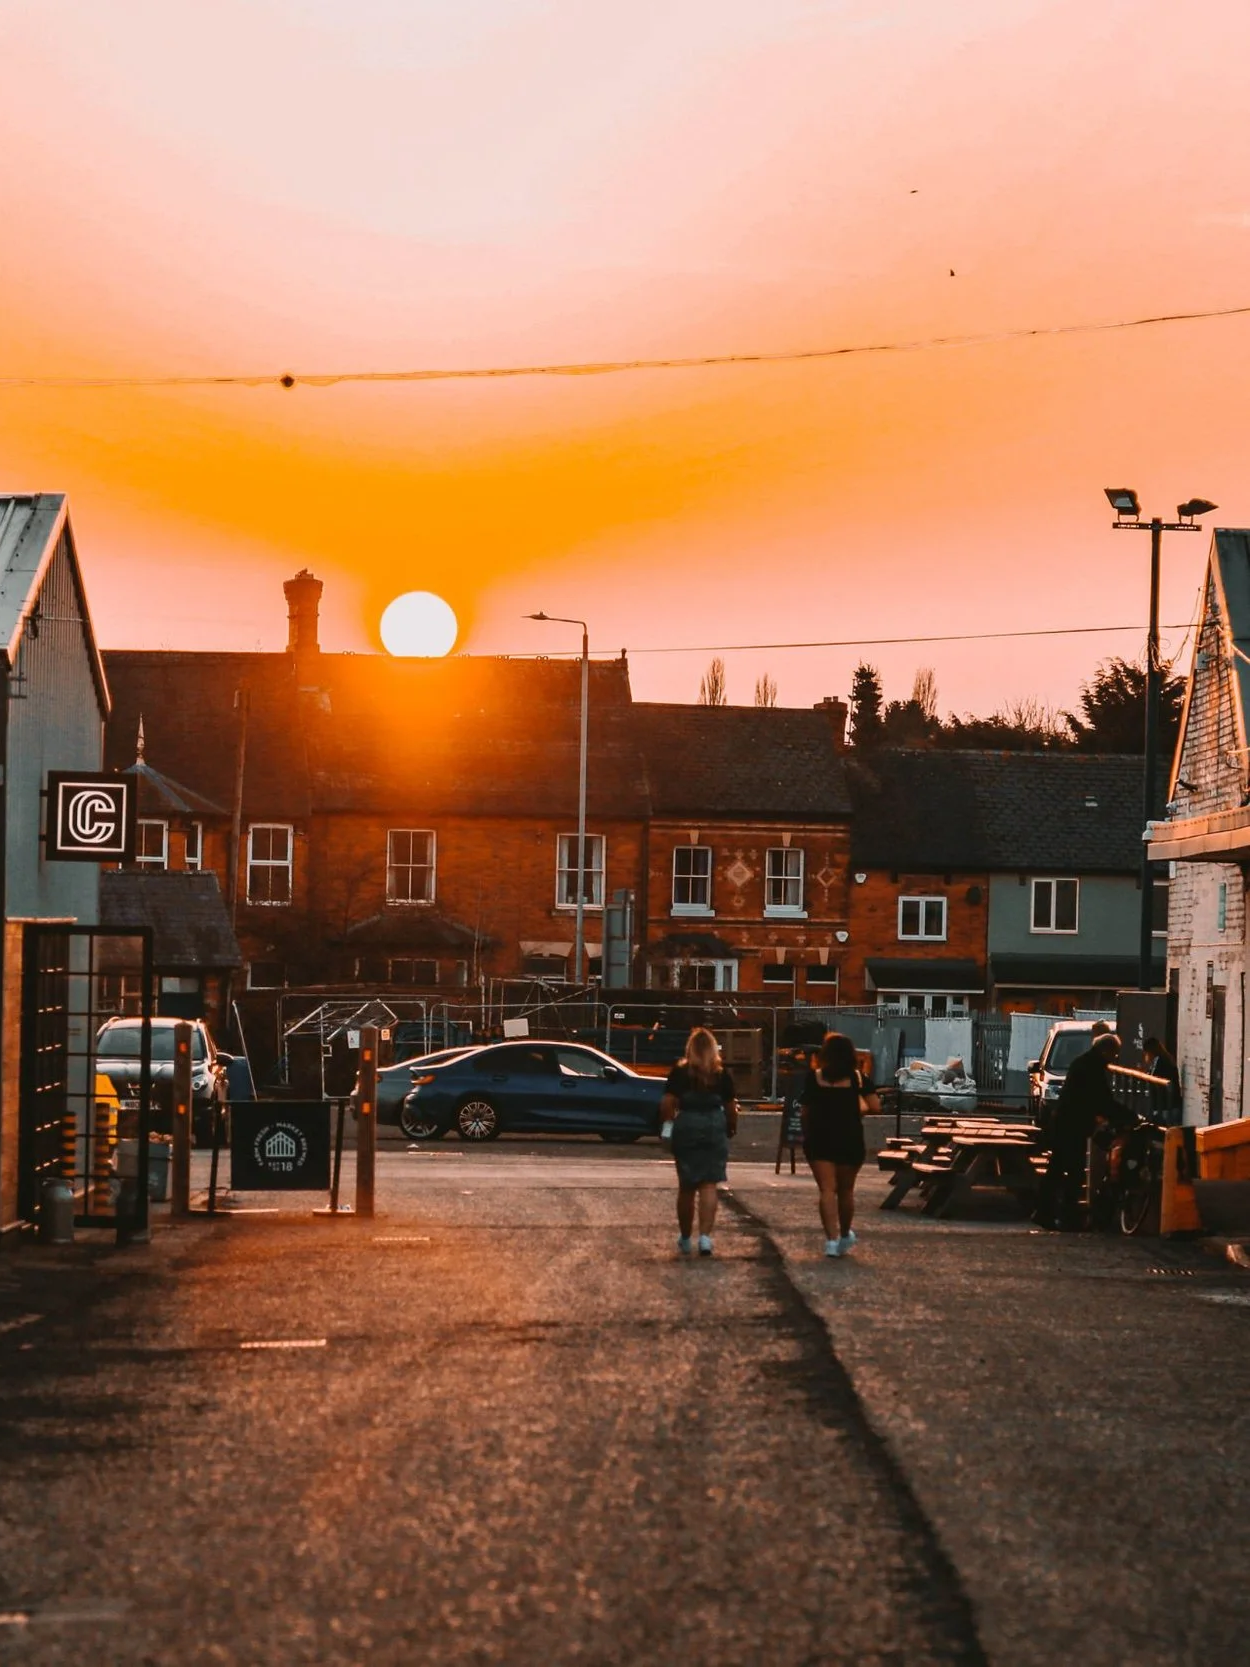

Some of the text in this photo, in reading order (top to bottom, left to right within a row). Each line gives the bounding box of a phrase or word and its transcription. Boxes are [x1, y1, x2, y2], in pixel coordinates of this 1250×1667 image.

[69, 791, 116, 844] C
[276, 1122, 304, 1137] MARKET
[281, 1161, 293, 1172] 18
